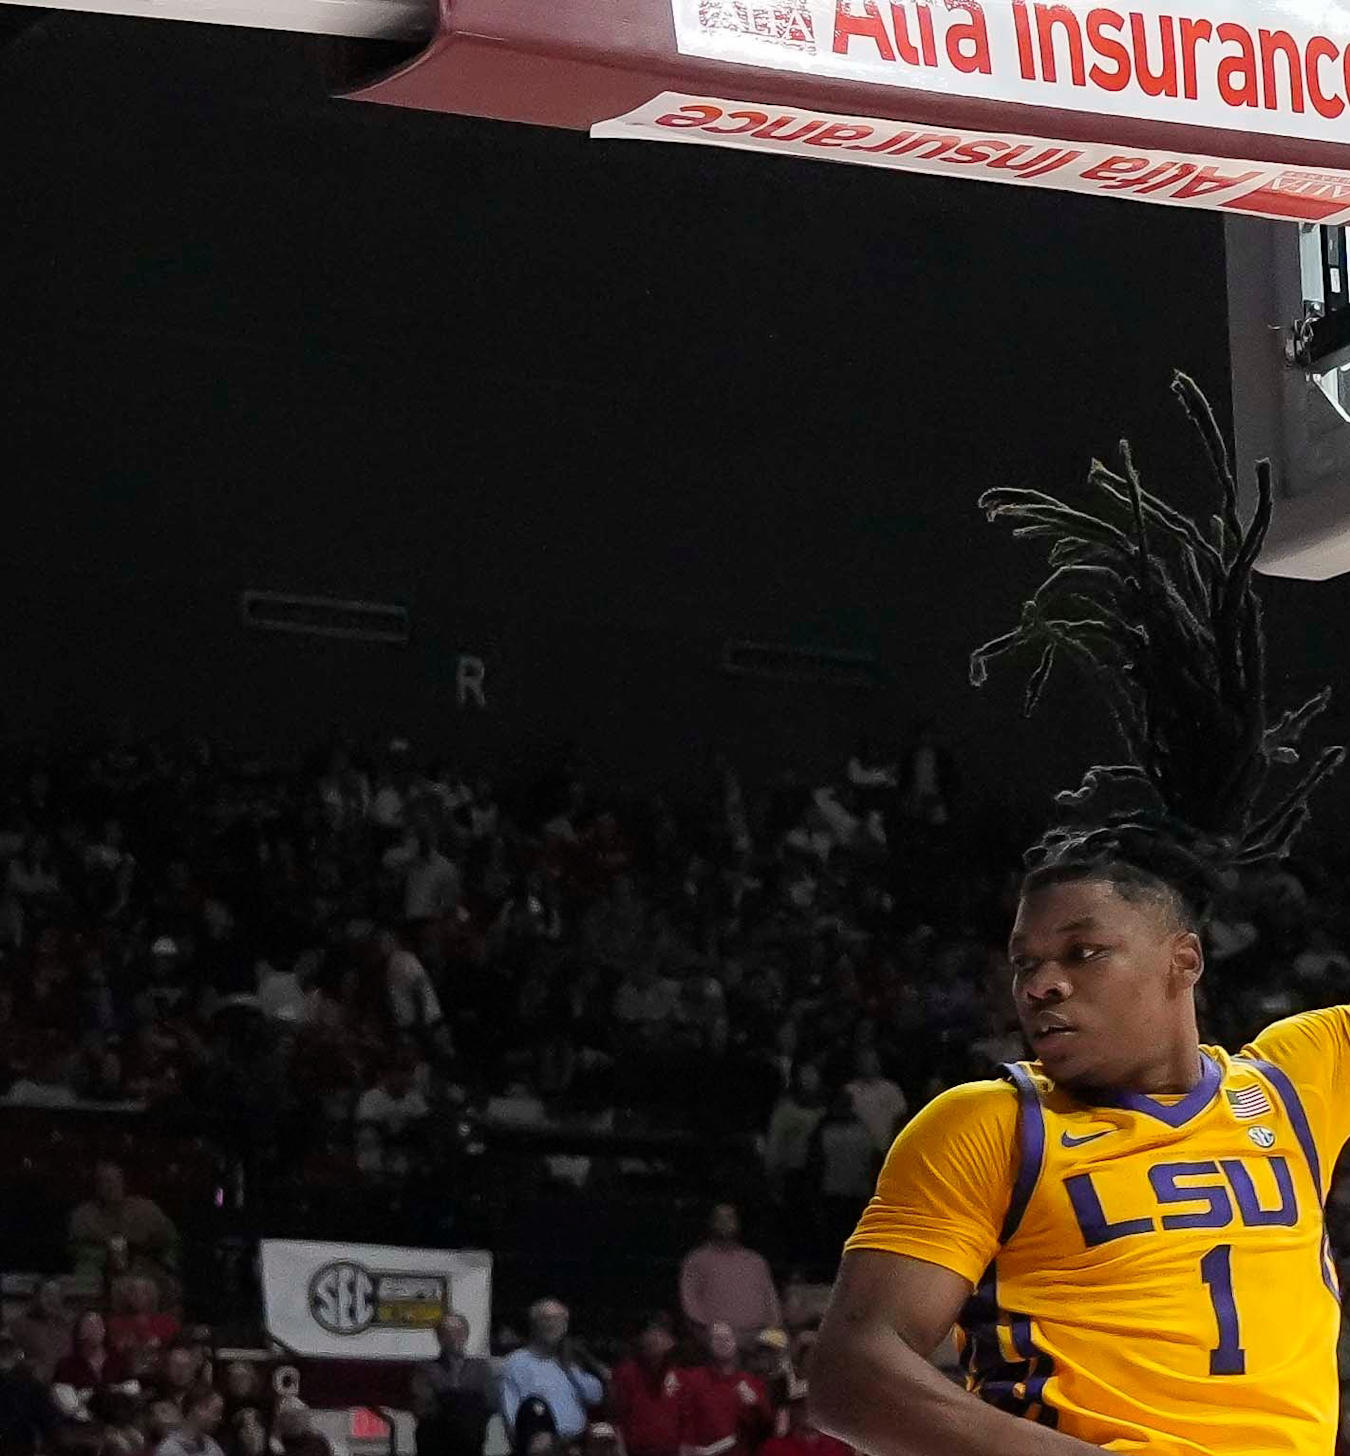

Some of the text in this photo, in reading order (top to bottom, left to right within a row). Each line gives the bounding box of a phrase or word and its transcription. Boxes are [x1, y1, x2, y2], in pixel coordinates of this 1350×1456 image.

[654, 104, 1263, 199] Alfa Insurance
[1062, 1156, 1299, 1248] LSU
[312, 1265, 375, 1330] SEC
[1200, 1244, 1246, 1376] 1
